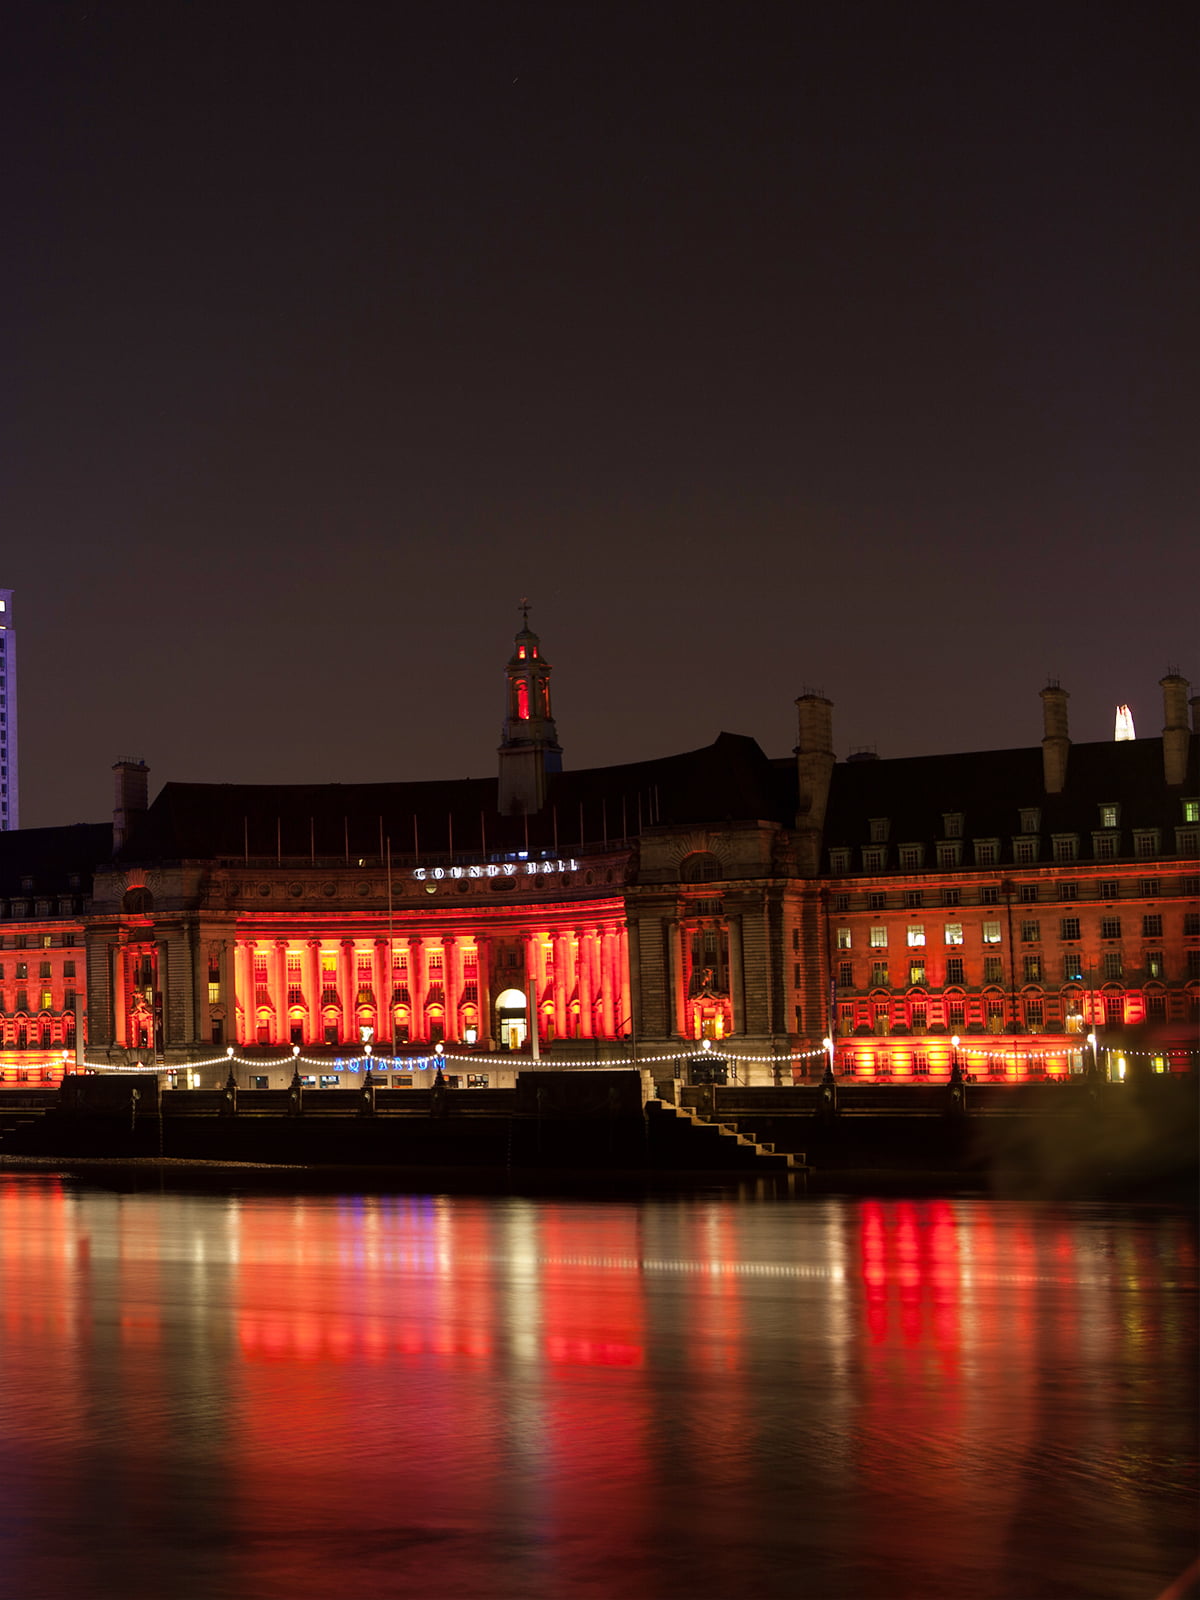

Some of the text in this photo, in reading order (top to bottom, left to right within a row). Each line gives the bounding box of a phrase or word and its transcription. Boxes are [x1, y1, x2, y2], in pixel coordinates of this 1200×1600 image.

[414, 858, 579, 880] COUNTY HALL
[333, 1056, 447, 1073] AQUARIUM
